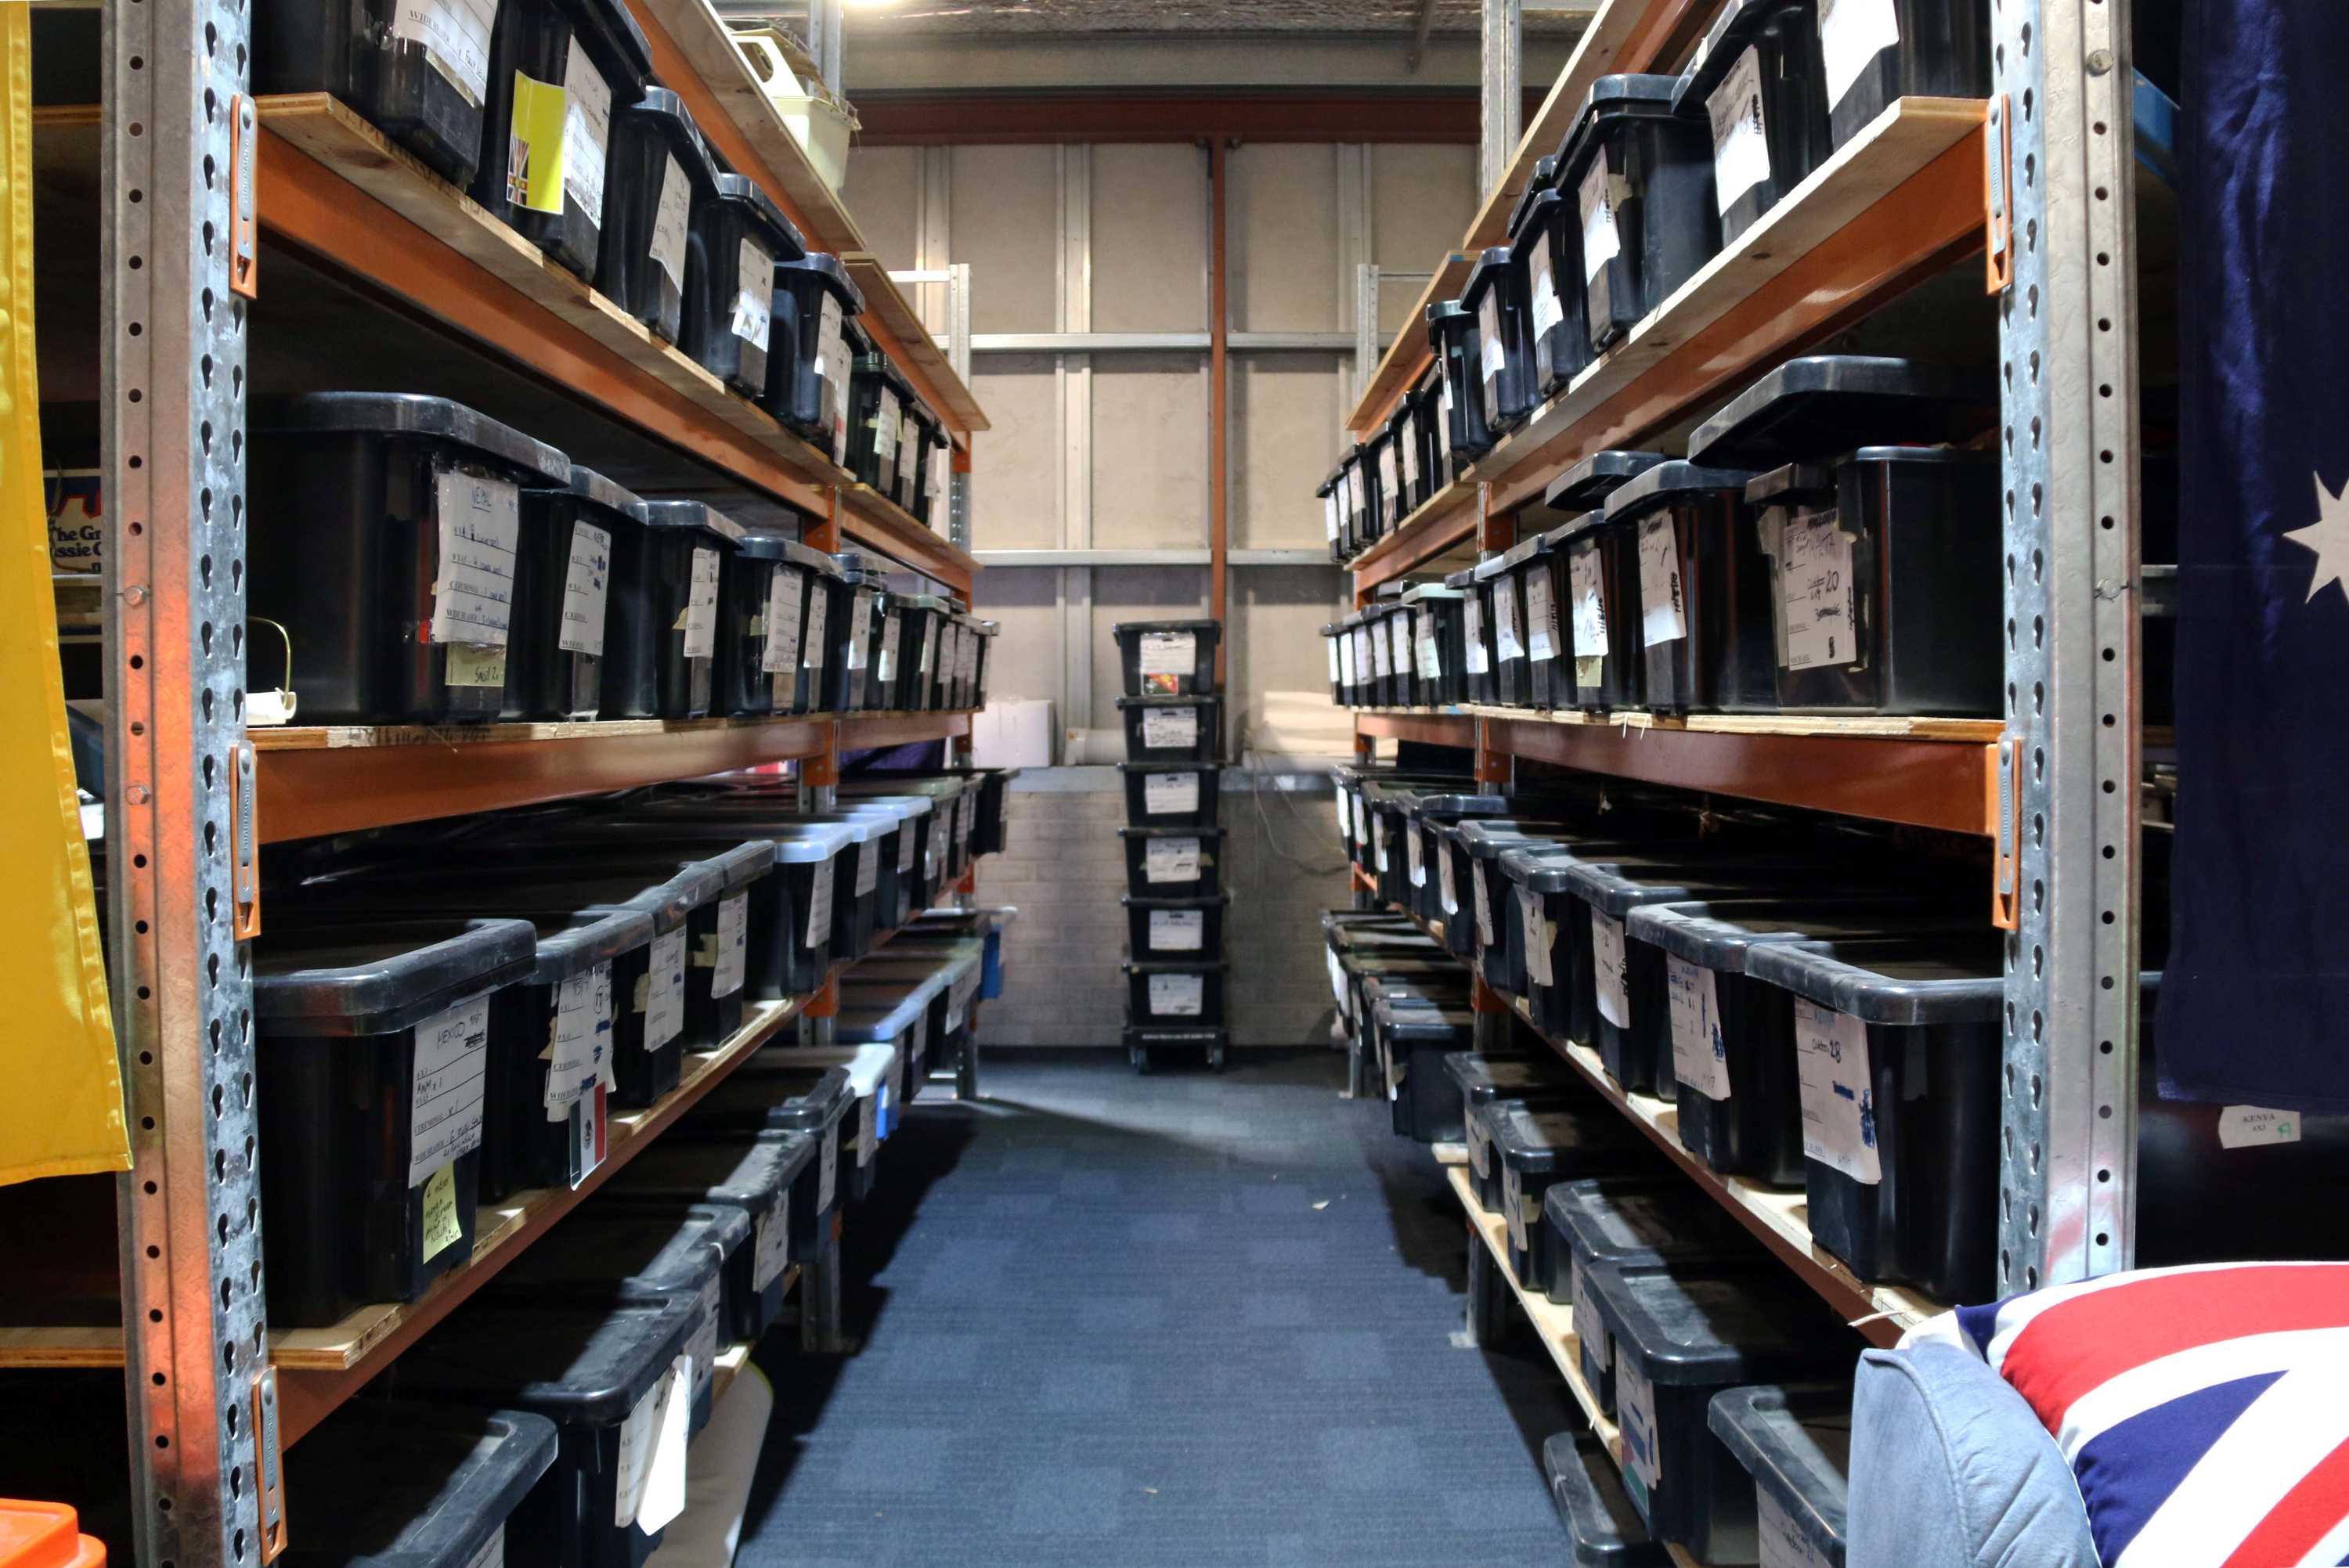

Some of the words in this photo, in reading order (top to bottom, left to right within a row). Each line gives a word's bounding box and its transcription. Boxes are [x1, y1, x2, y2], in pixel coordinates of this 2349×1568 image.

[1826, 570, 1839, 593] 20
[1830, 1040, 1842, 1064] 28
[2243, 1114, 2276, 1123] KENYA
